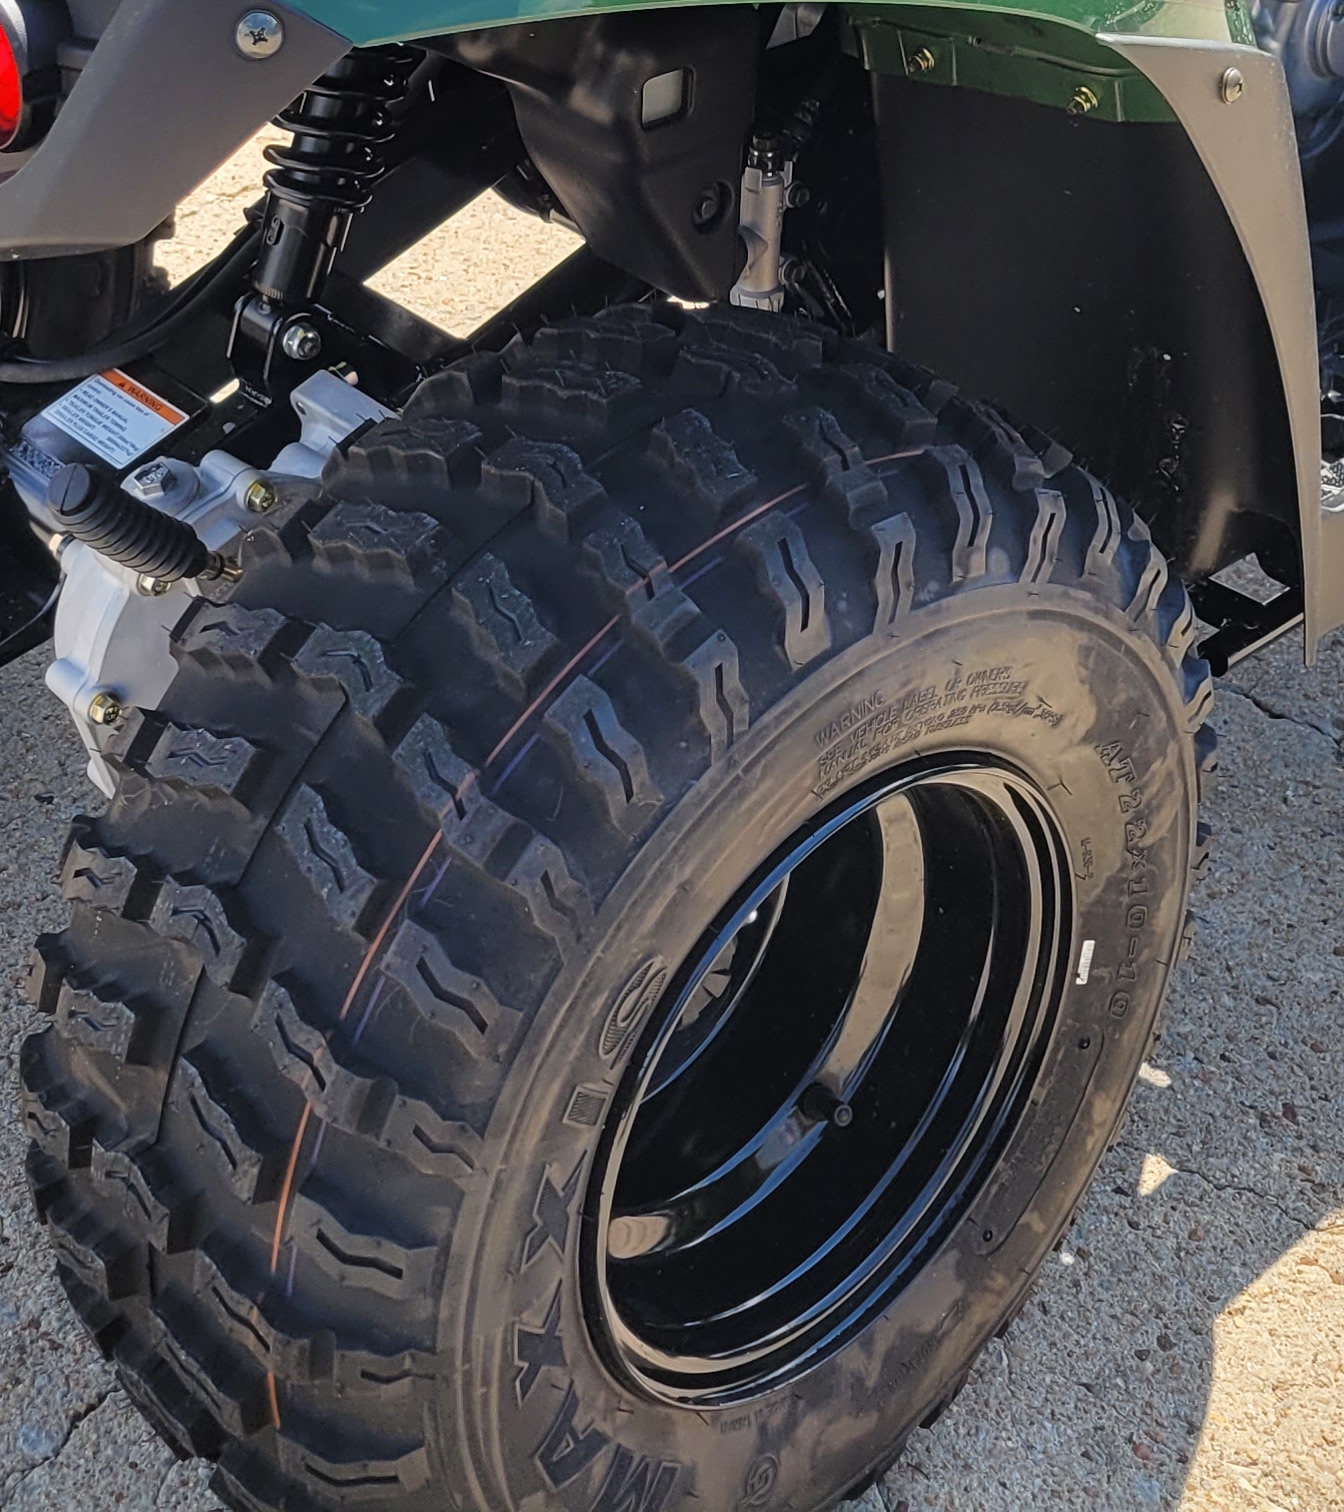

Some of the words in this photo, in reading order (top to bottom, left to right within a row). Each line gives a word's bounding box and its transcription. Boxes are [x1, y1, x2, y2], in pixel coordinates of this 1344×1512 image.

[129, 387, 164, 412] WARNING
[815, 690, 885, 748] WARNING
[818, 739, 870, 781] MANUAL
[873, 718, 901, 742] FOR
[903, 689, 968, 725] OPERATING
[851, 707, 898, 745] VEHICLE
[902, 686, 938, 711] LABEL
